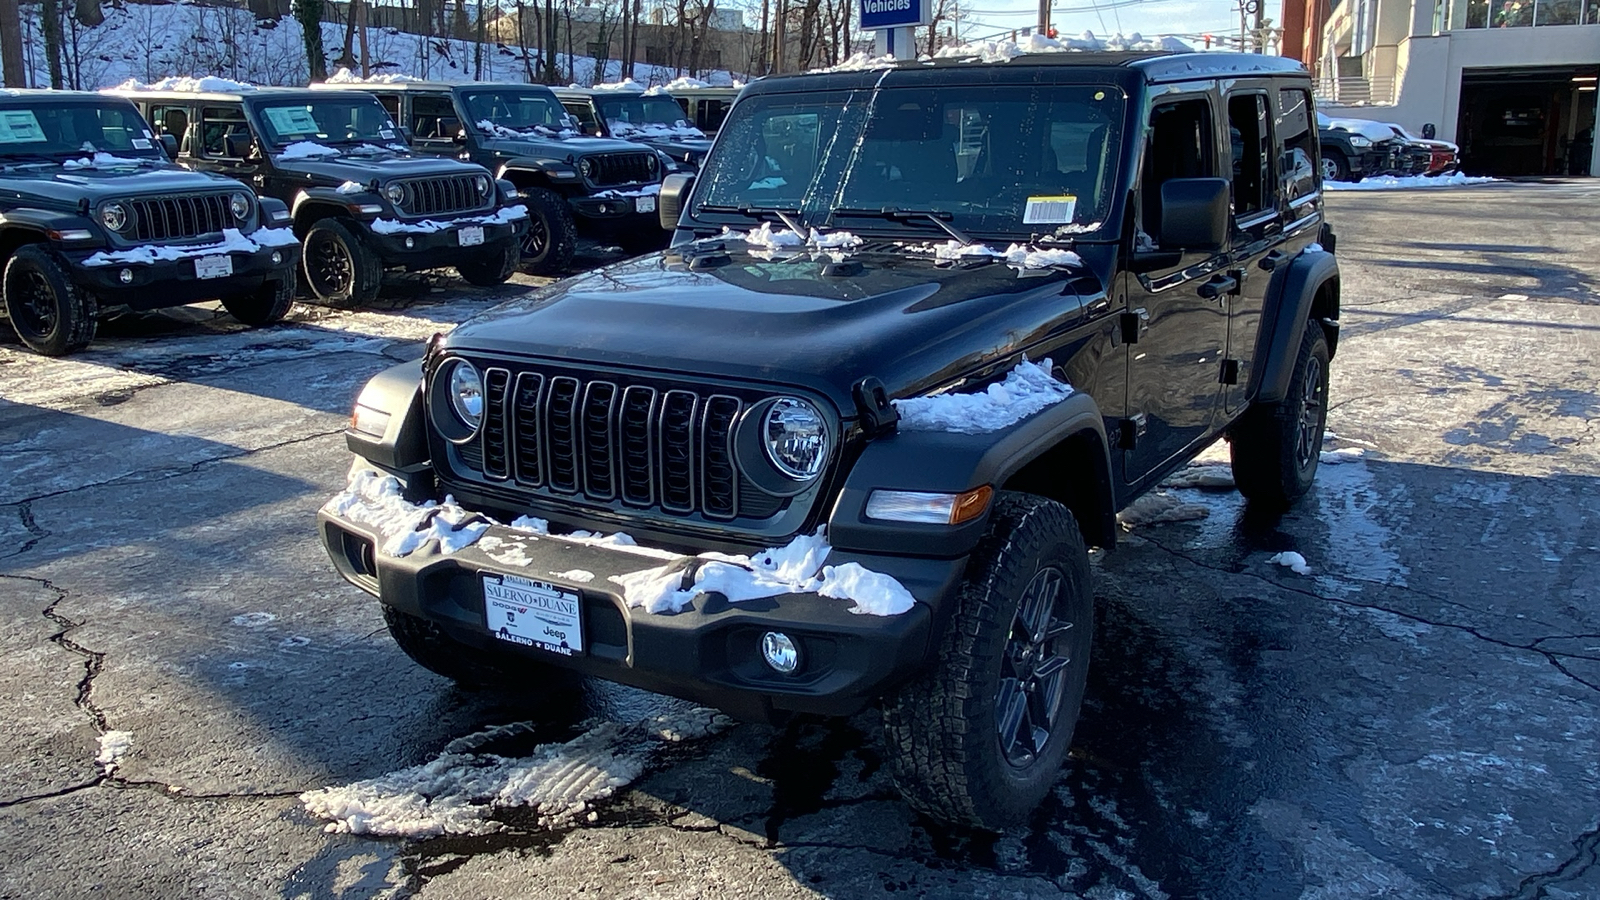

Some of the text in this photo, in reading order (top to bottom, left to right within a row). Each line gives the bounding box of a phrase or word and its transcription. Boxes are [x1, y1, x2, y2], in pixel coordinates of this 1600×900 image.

[864, 0, 910, 13] Vehicles
[486, 585, 577, 616] SALERNO DUANE
[543, 627, 566, 640] Jeep
[495, 632, 571, 656] SALERNO DUANE
